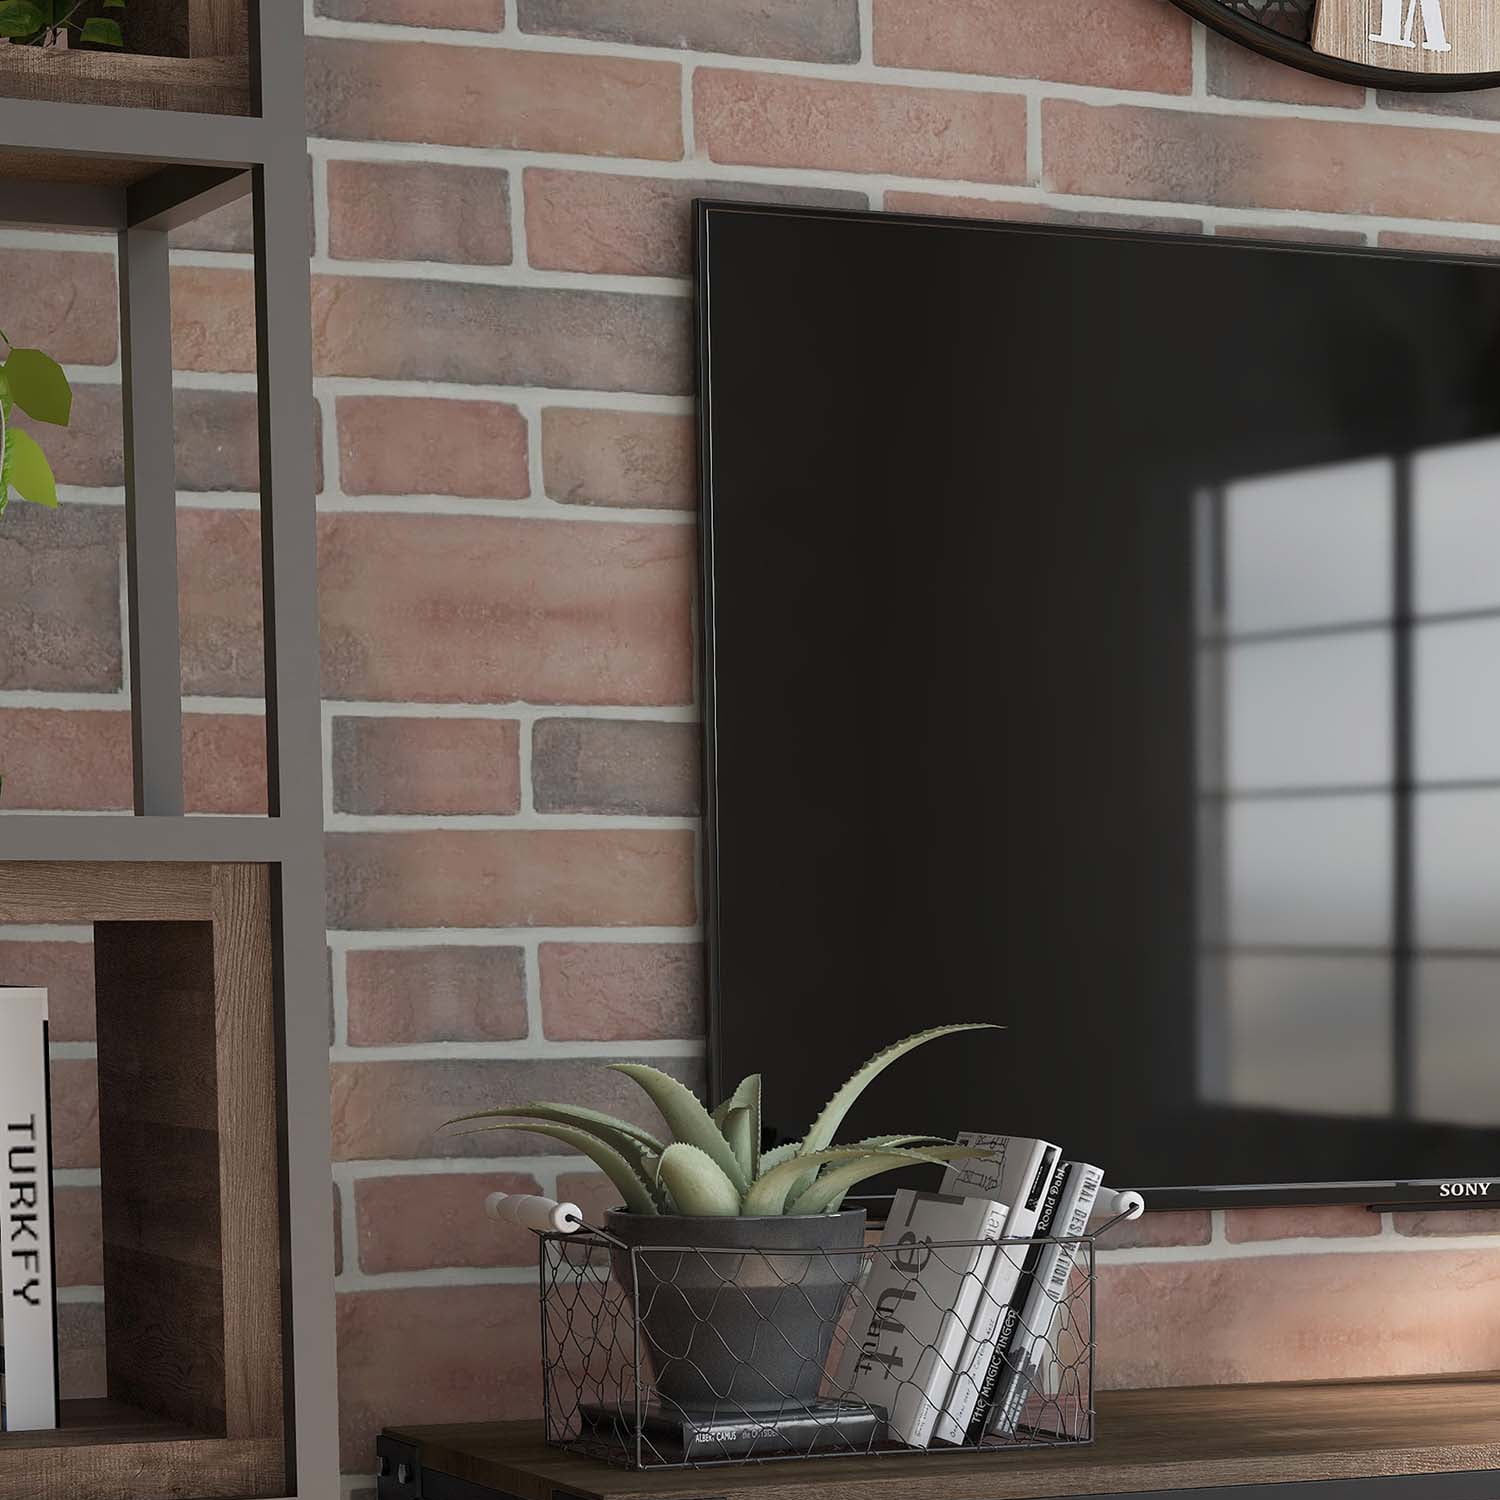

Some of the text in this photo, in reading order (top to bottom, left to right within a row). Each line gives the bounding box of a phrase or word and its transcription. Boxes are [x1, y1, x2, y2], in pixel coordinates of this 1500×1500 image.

[8, 1113, 41, 1306] TURKFY
[1037, 1196, 1056, 1231] Roald
[1050, 1166, 1067, 1196] Dahl
[1078, 1168, 1100, 1204] FINAL
[1439, 1182, 1492, 1197] SONY
[1050, 1209, 1088, 1286] DESTNATION
[971, 1400, 987, 1424] THE
[982, 1353, 1001, 1400] MAGIC
[695, 1430, 716, 1443] ALBERT
[717, 1430, 737, 1442] CAMUS
